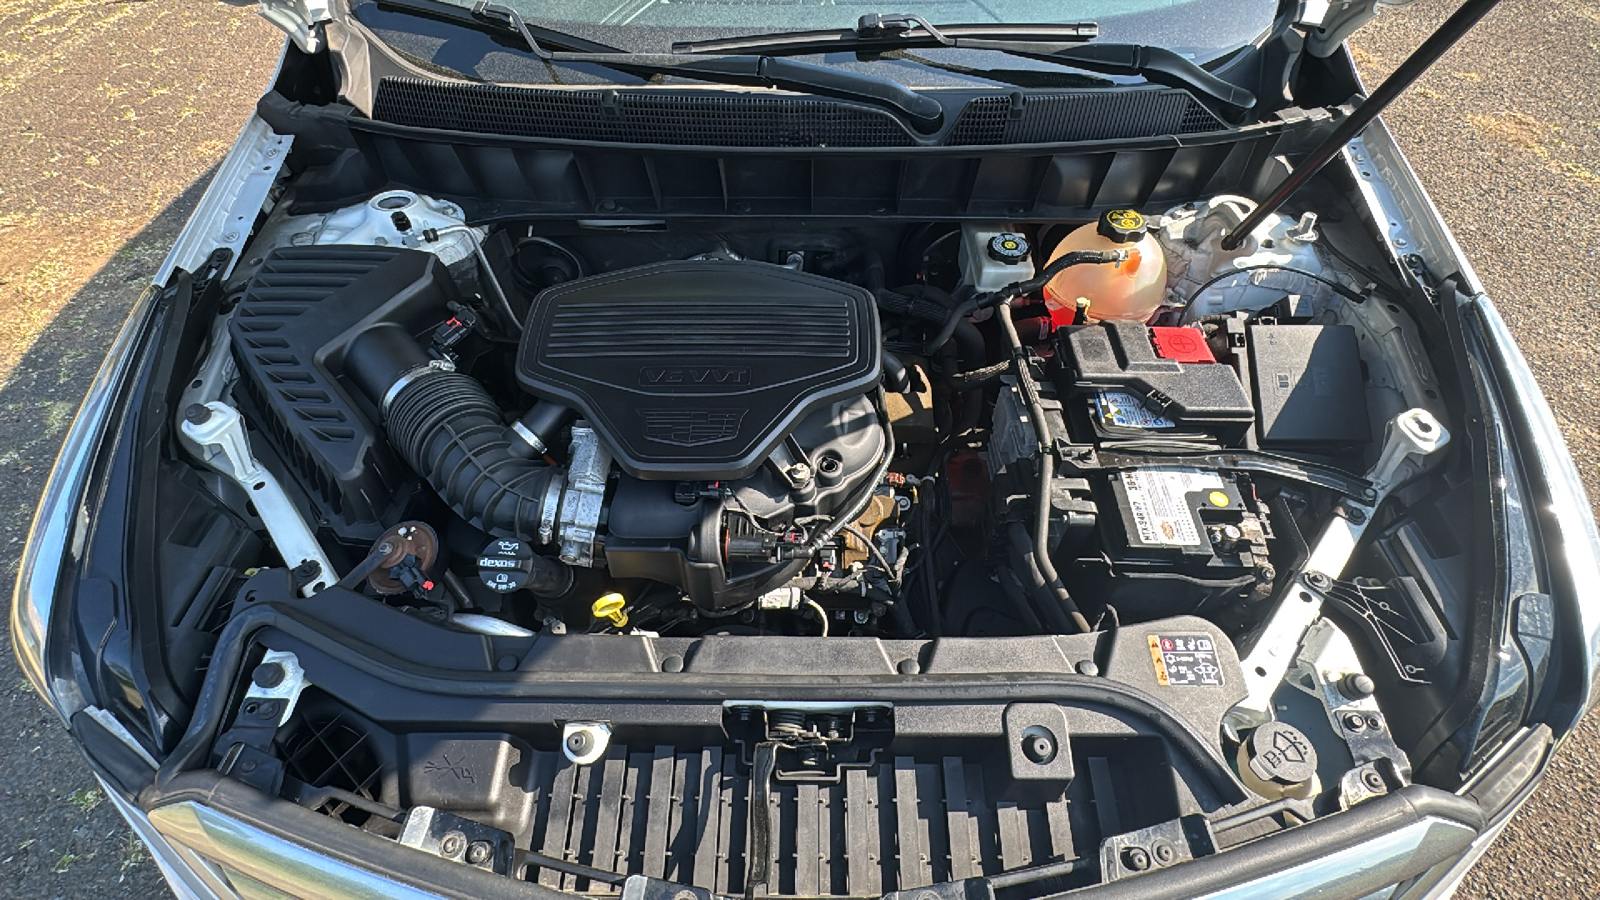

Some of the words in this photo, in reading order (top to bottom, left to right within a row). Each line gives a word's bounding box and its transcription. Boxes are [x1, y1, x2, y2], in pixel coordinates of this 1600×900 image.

[645, 369, 683, 382] V6
[689, 369, 747, 382] VVT
[479, 557, 516, 568] dexos
